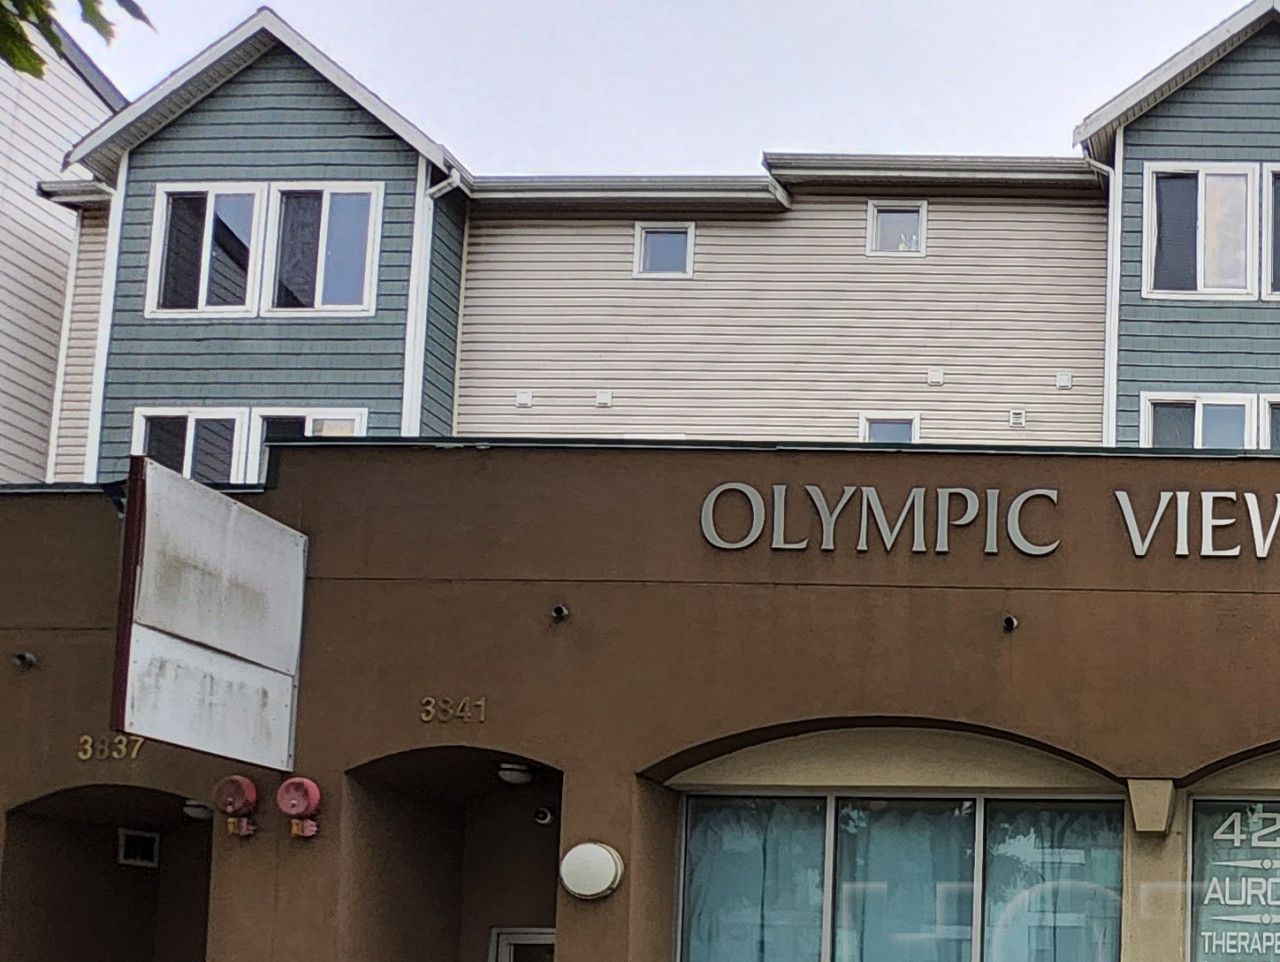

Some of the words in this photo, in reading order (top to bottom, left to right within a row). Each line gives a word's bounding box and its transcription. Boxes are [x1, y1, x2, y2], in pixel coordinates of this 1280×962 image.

[700, 482, 1062, 555] OLYMPIC
[420, 696, 487, 722] 3841
[77, 734, 145, 760] 3837
